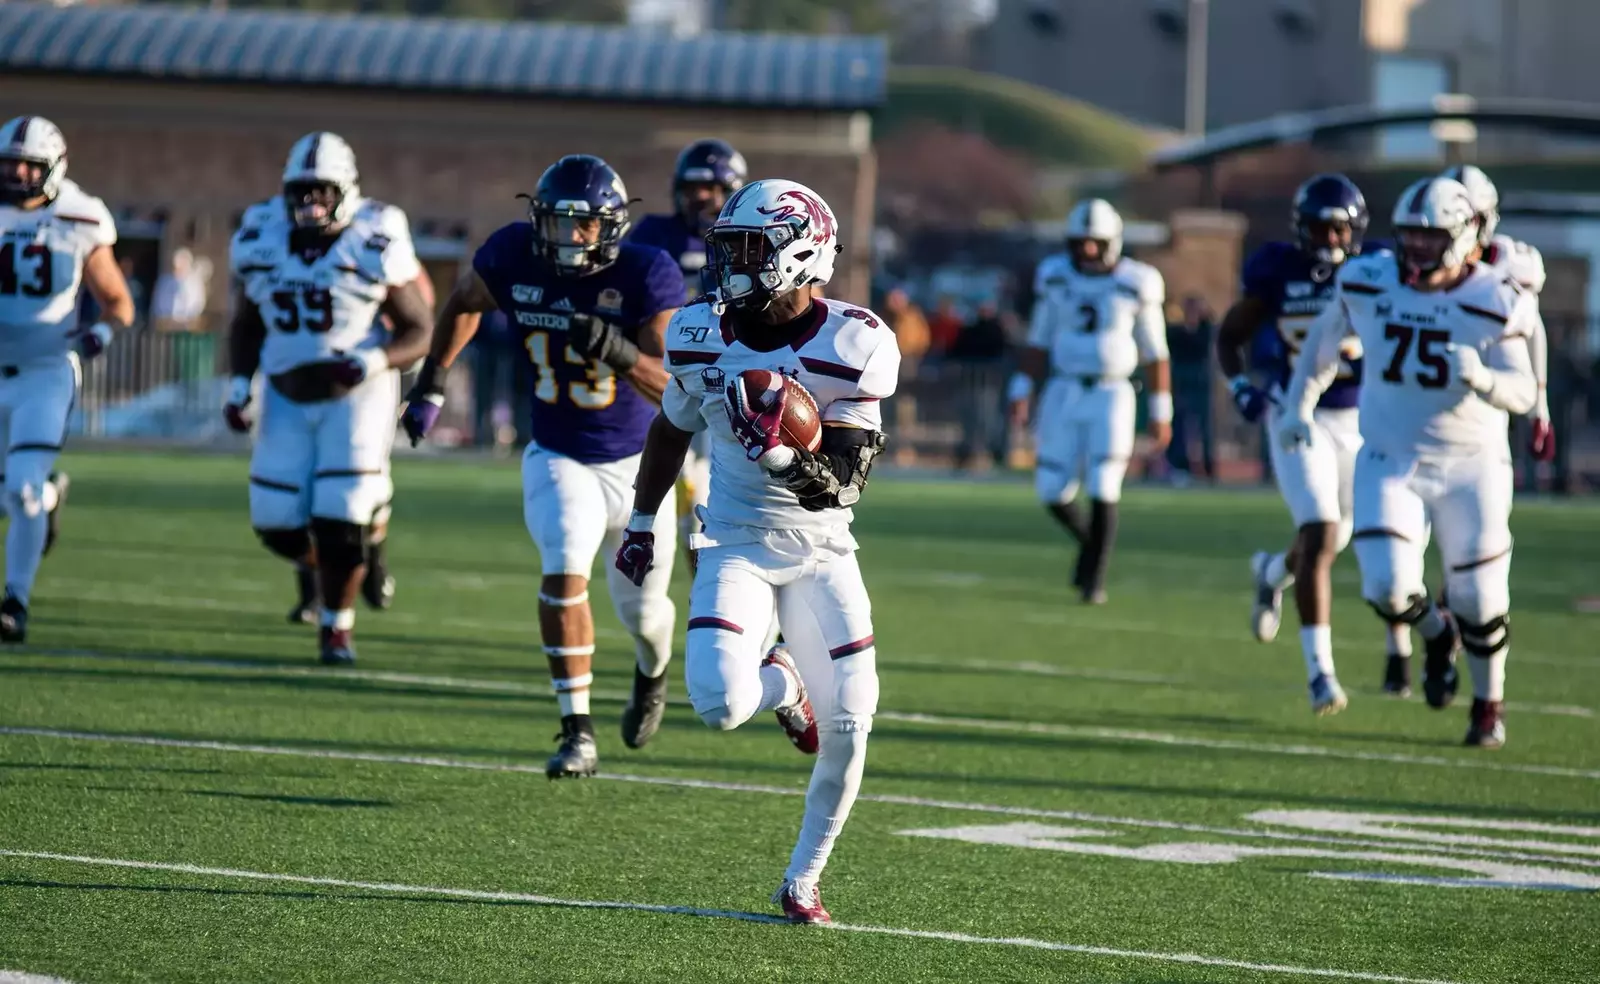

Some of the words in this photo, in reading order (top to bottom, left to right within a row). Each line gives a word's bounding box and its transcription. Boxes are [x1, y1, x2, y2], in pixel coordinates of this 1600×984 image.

[272, 288, 333, 333] 59
[515, 310, 570, 331] WESTERN
[525, 331, 616, 409] 13
[1382, 322, 1450, 389] 75
